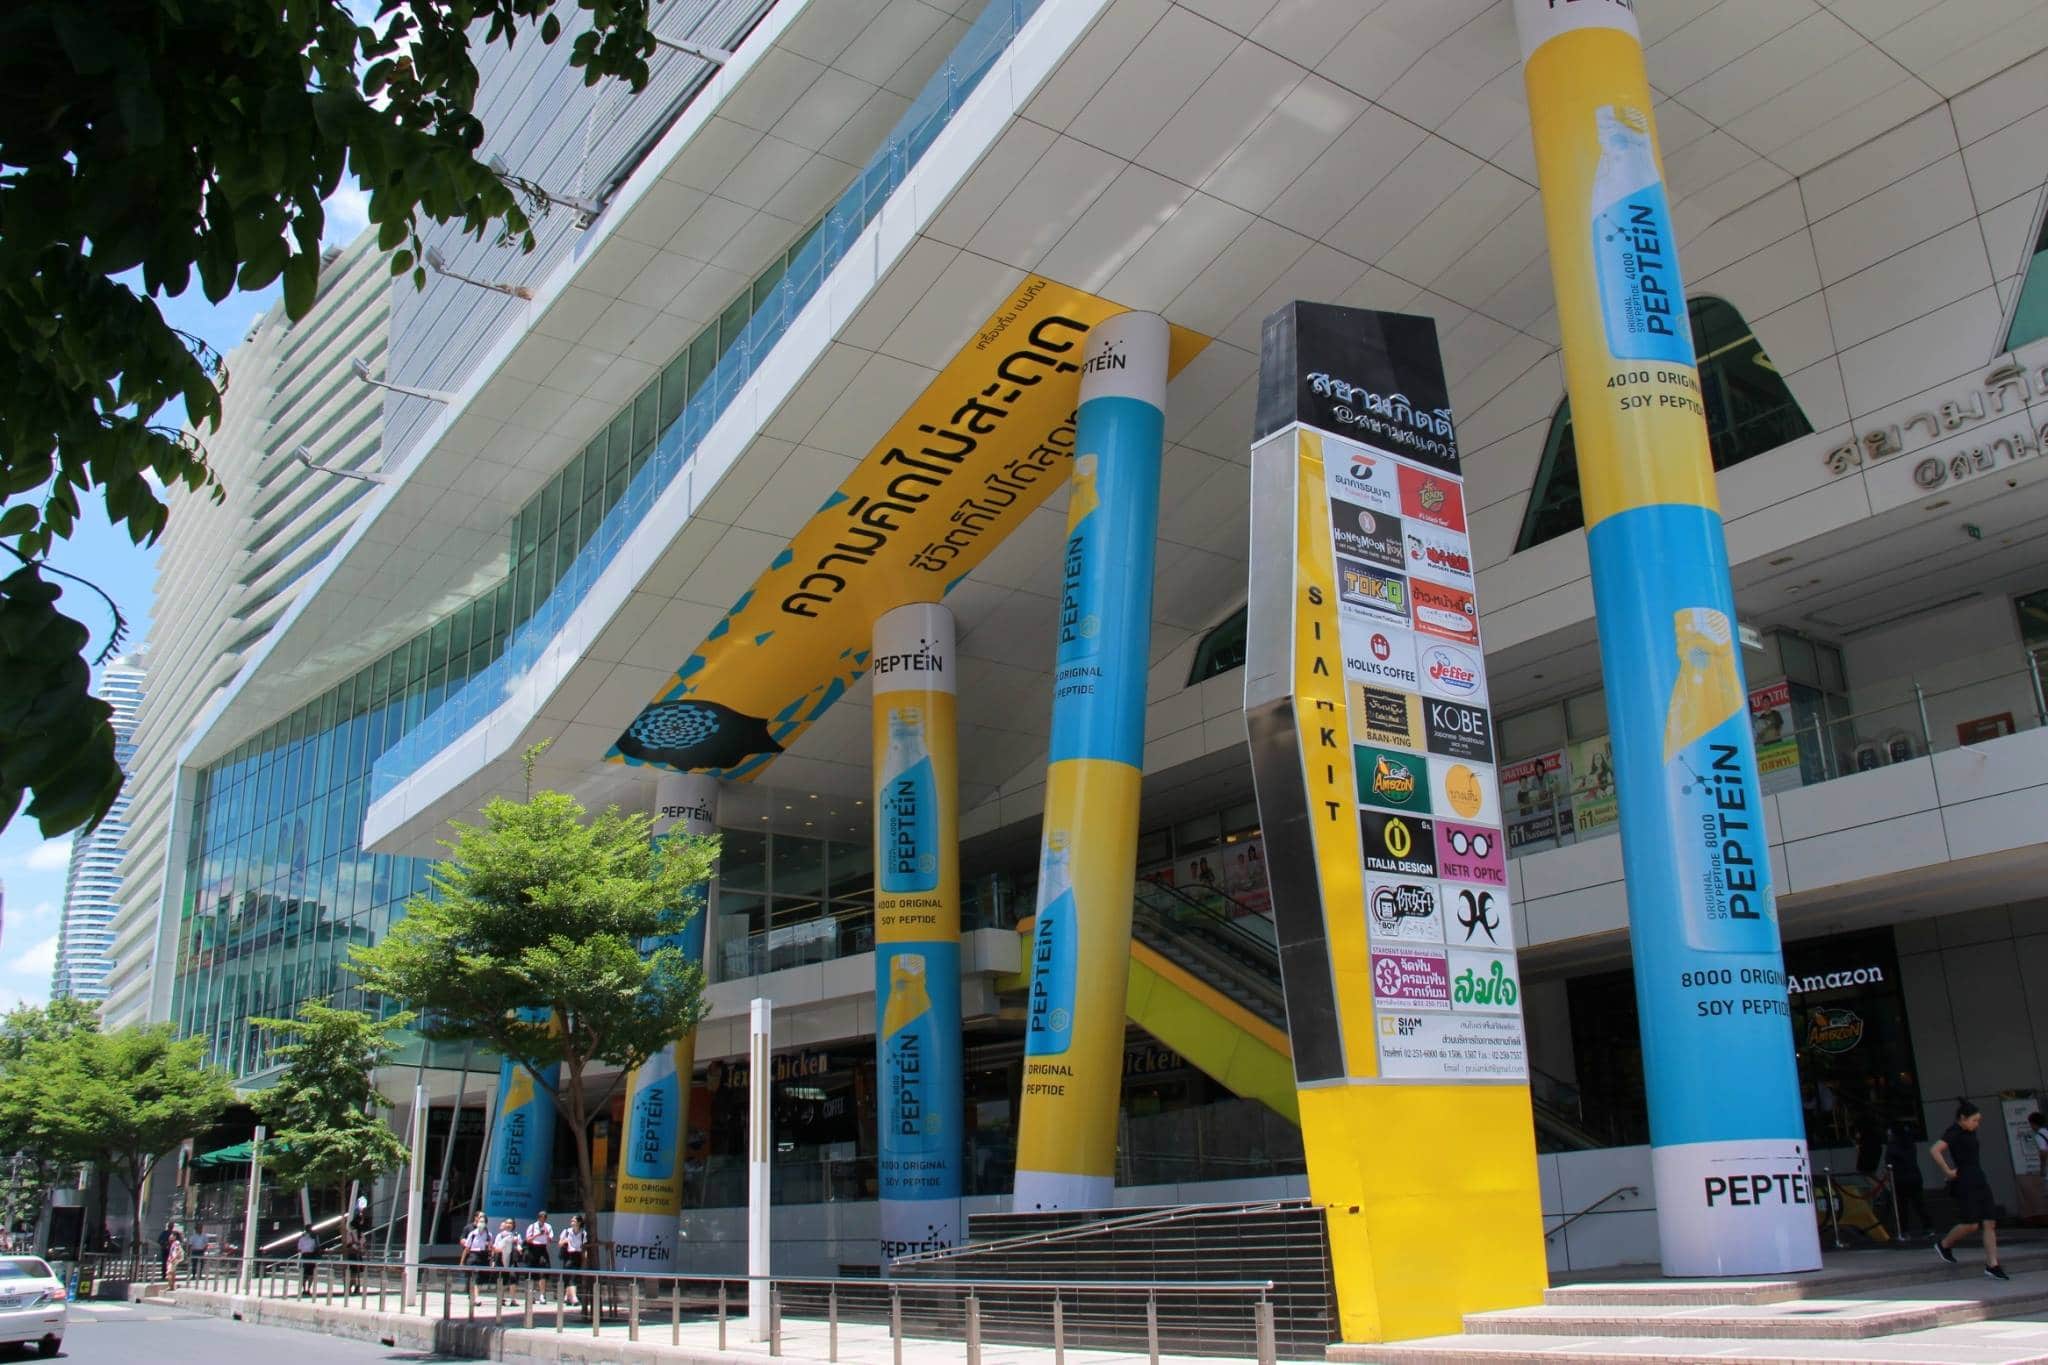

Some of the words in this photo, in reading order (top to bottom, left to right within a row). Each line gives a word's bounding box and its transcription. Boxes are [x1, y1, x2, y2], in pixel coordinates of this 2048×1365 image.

[1623, 253, 1636, 280] 4000
[1607, 371, 1649, 388] 4000
[1657, 371, 1700, 392] ORIGIN
[1620, 395, 1652, 410] SOY
[782, 315, 1090, 618] ความคิดไม่สะดุด
[1347, 658, 1381, 674] HOLLYS
[1383, 666, 1416, 682] COFFEE
[1430, 661, 1474, 682] Jeffer
[1432, 704, 1484, 736] KOBE
[1367, 732, 1412, 748] BAAN-YING
[1703, 814, 1717, 849] 8000
[1367, 857, 1397, 869] ITALIA
[1399, 862, 1434, 875] DESIGN
[1444, 863, 1470, 878] NETR
[1473, 867, 1503, 881] OPTIC
[1711, 853, 1725, 898] PEPTIDE
[899, 899, 942, 909] ORIGINAL
[1704, 871, 1717, 920] ORIGINAL
[1717, 900, 1728, 919] SOY
[882, 915, 895, 925] SOY
[899, 915, 937, 925] PEPTIDE
[1400, 958, 1431, 972] จัดฟัน
[1454, 960, 1517, 1006] สมใจ
[1681, 969, 1732, 988] 8000
[1740, 968, 1787, 985] ORIGIN
[1786, 966, 1884, 995] Amazon
[1697, 999, 1734, 1017] SOY
[1398, 1017, 1422, 1027] SIAM
[1399, 1027, 1415, 1036] KIT
[1127, 1048, 1181, 1073] icken
[1029, 1064, 1073, 1077] ORIGINAL
[1026, 1084, 1065, 1096] PEPTIDE
[903, 1160, 947, 1170] ORIGINAL
[1704, 1172, 1814, 1207] PEPTEi
